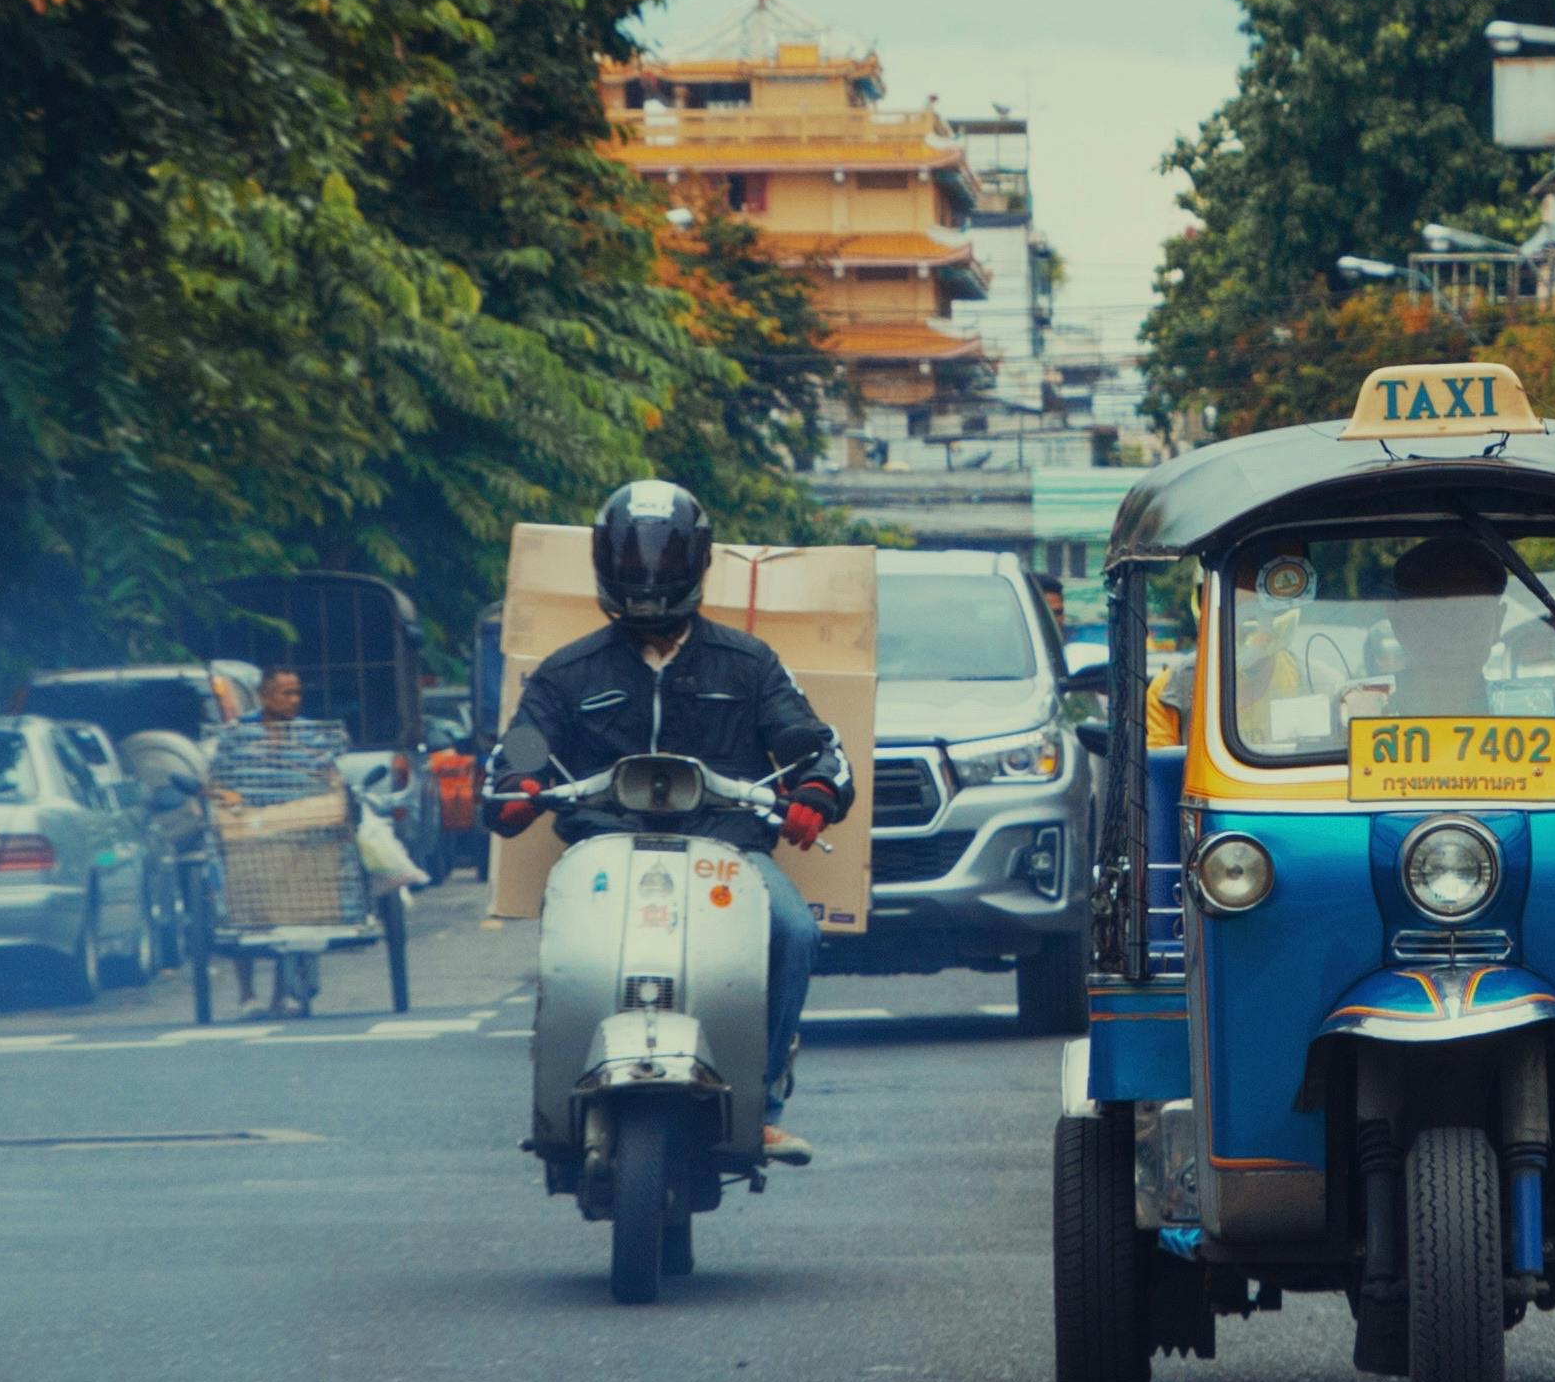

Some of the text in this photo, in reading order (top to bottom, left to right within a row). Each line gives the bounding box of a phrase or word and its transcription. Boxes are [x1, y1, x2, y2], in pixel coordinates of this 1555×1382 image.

[1375, 376, 1499, 421] TAXI
[1372, 723, 1552, 764] สก 7402
[1382, 776, 1527, 796] กรุงเทพมหานคร
